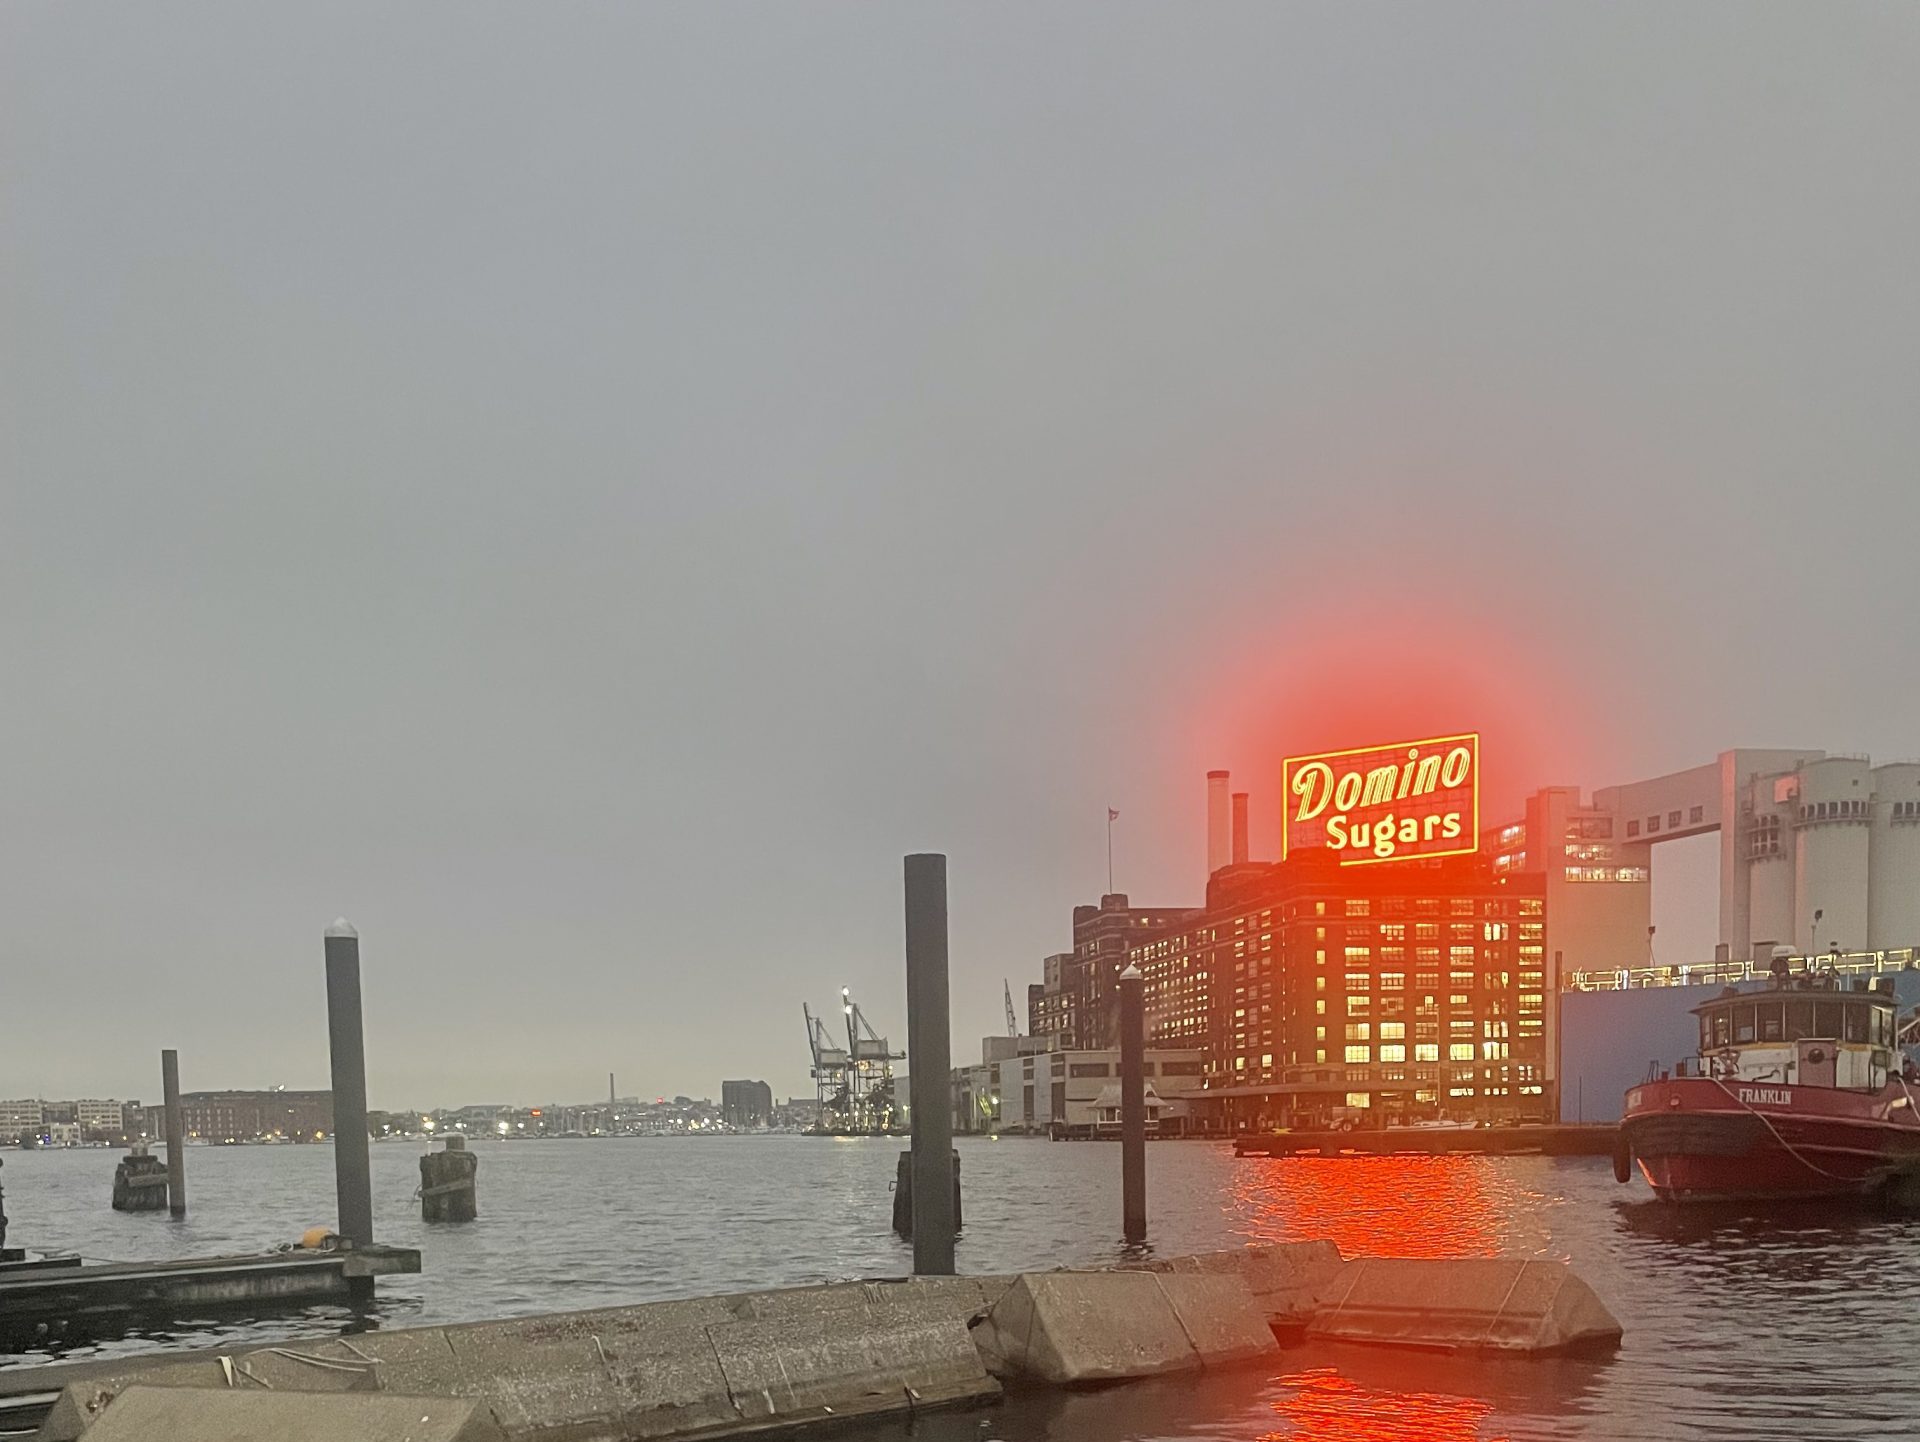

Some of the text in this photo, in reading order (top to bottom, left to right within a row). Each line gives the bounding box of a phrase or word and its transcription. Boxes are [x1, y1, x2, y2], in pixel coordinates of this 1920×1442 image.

[1291, 747, 1471, 822] Domino
[1326, 812, 1461, 857] Sugars
[1739, 1088, 1791, 1104] FRANKLIN
